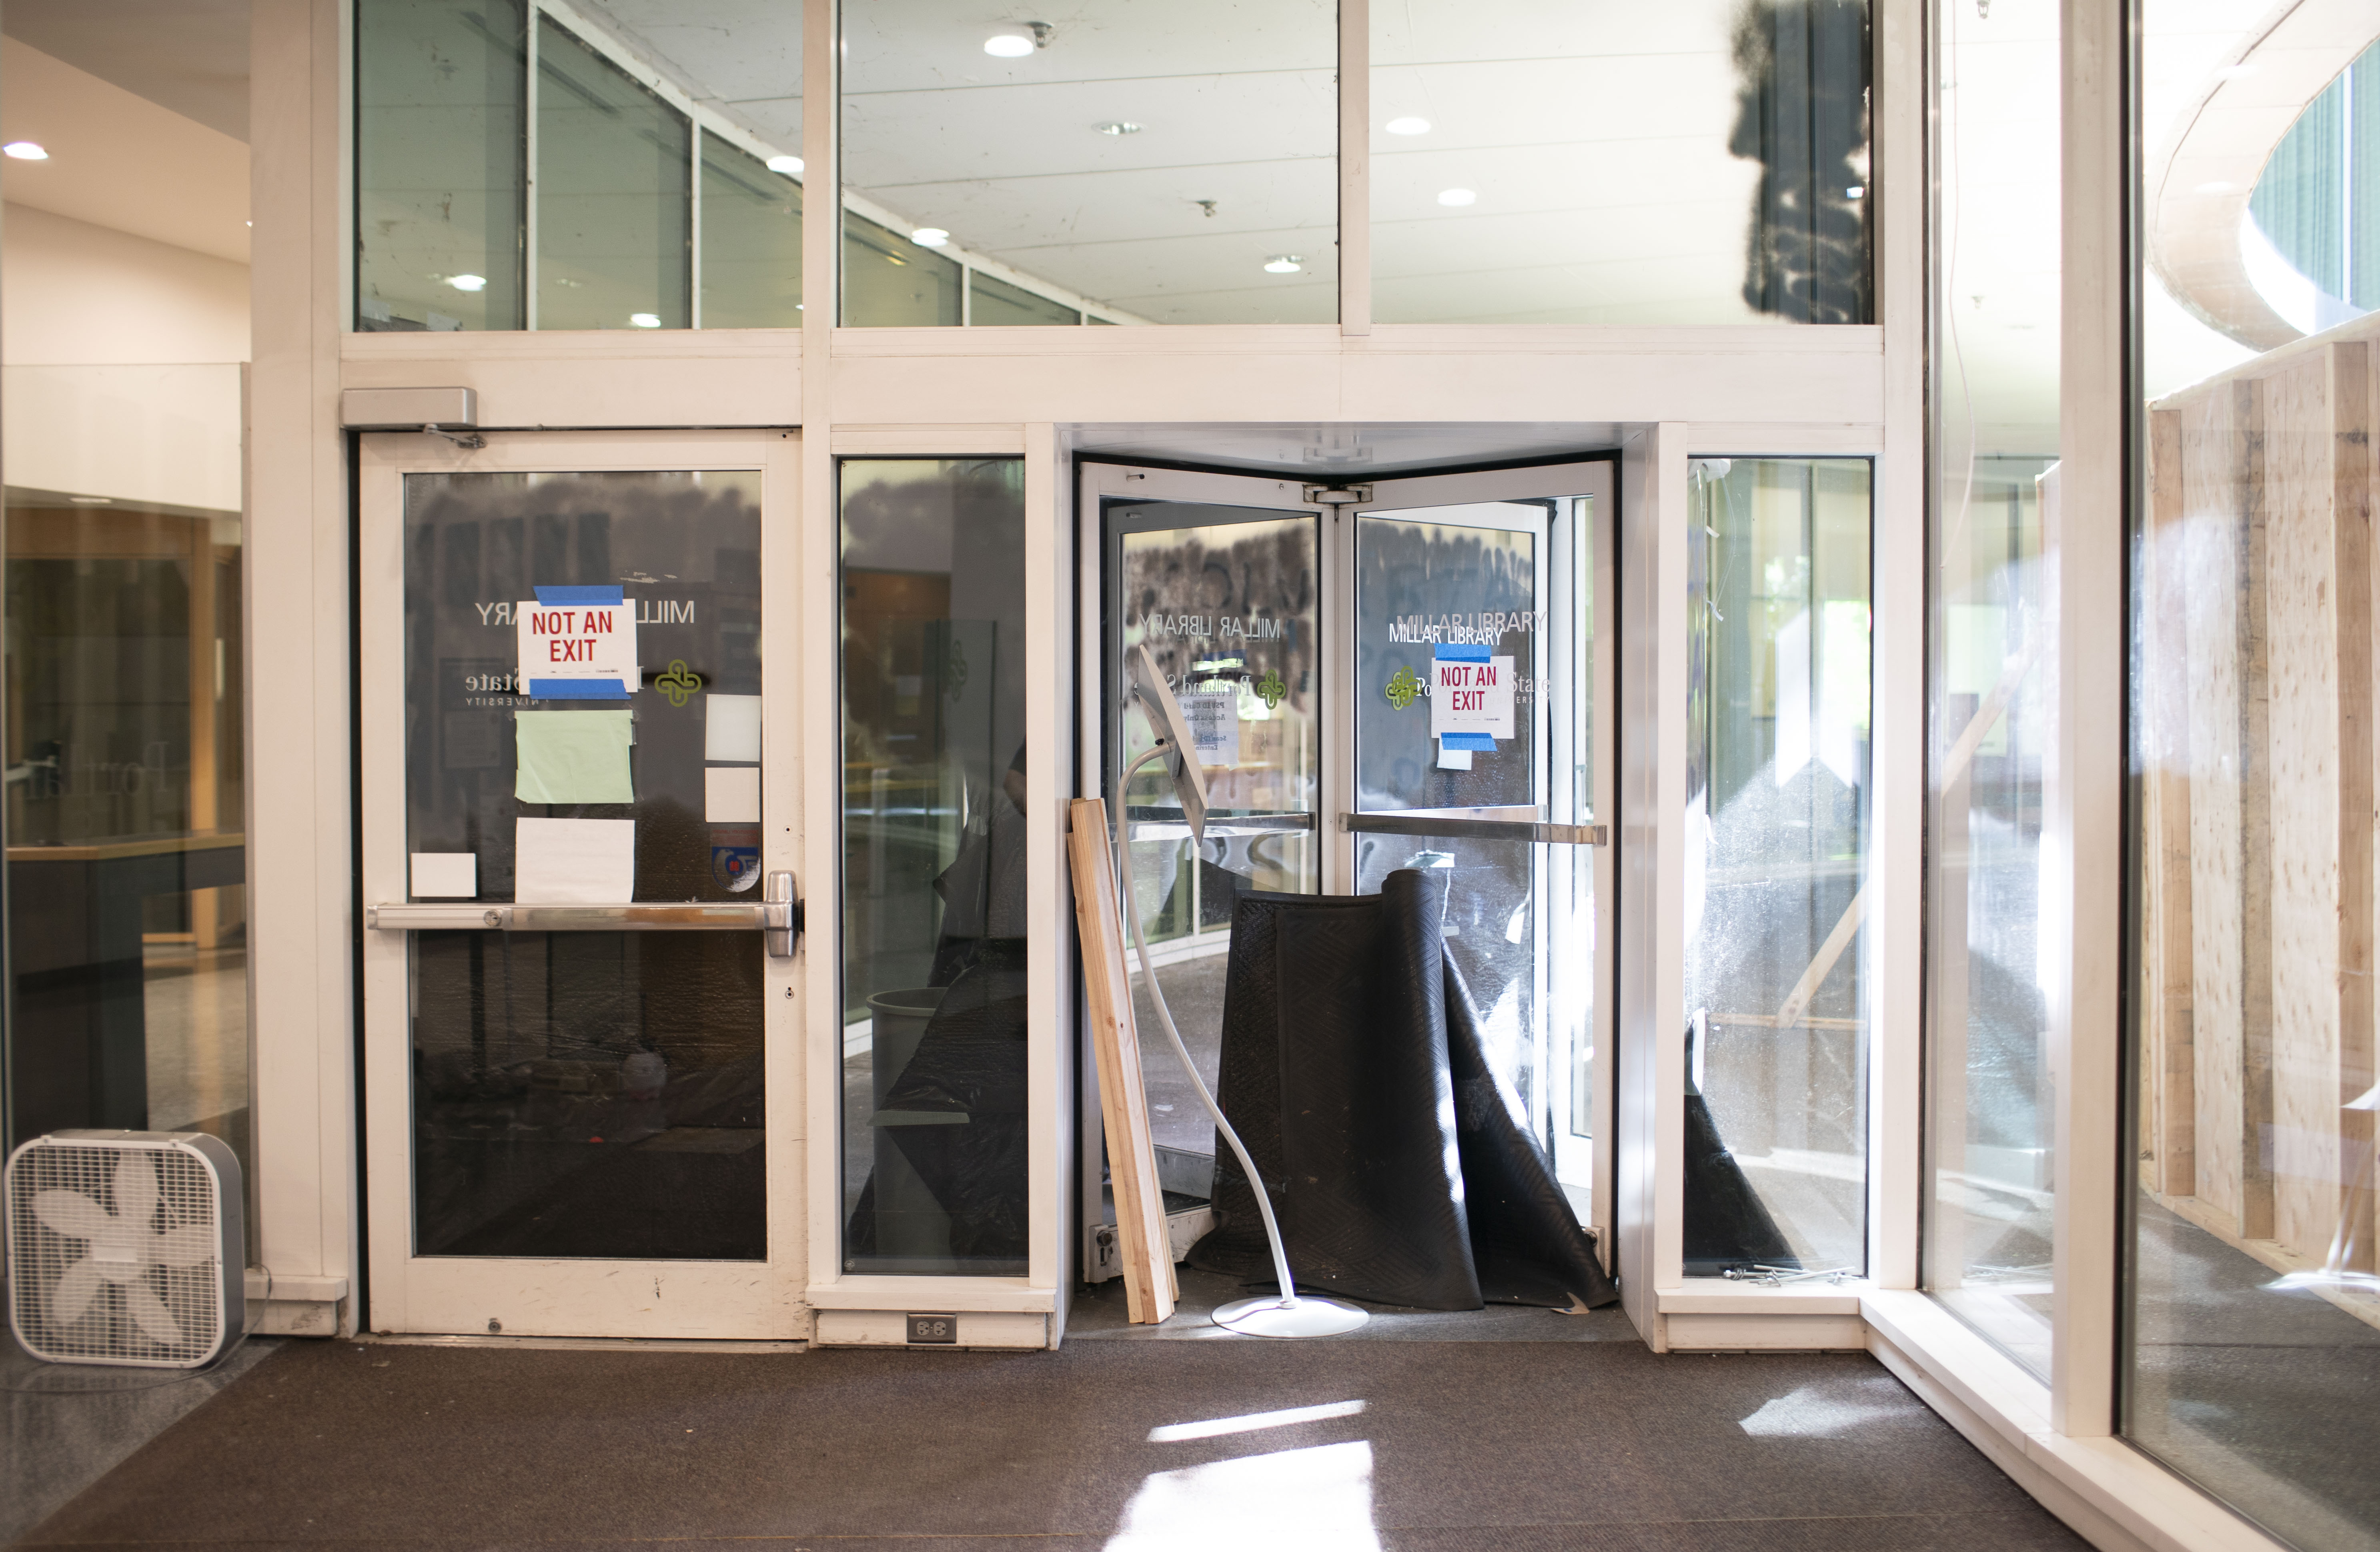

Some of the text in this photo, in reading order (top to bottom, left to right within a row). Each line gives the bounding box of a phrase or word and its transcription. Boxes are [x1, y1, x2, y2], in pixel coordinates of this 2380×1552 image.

[532, 612, 575, 635] NOT
[583, 611, 613, 634] AN
[1389, 623, 1503, 646] MILLAR LIBRARY
[1396, 611, 1548, 635] MILLAR LIBRARY
[550, 639, 597, 662] EXIT
[1441, 666, 1497, 687] NOT AN
[1507, 671, 1551, 693] State
[1452, 691, 1485, 711] EXIT
